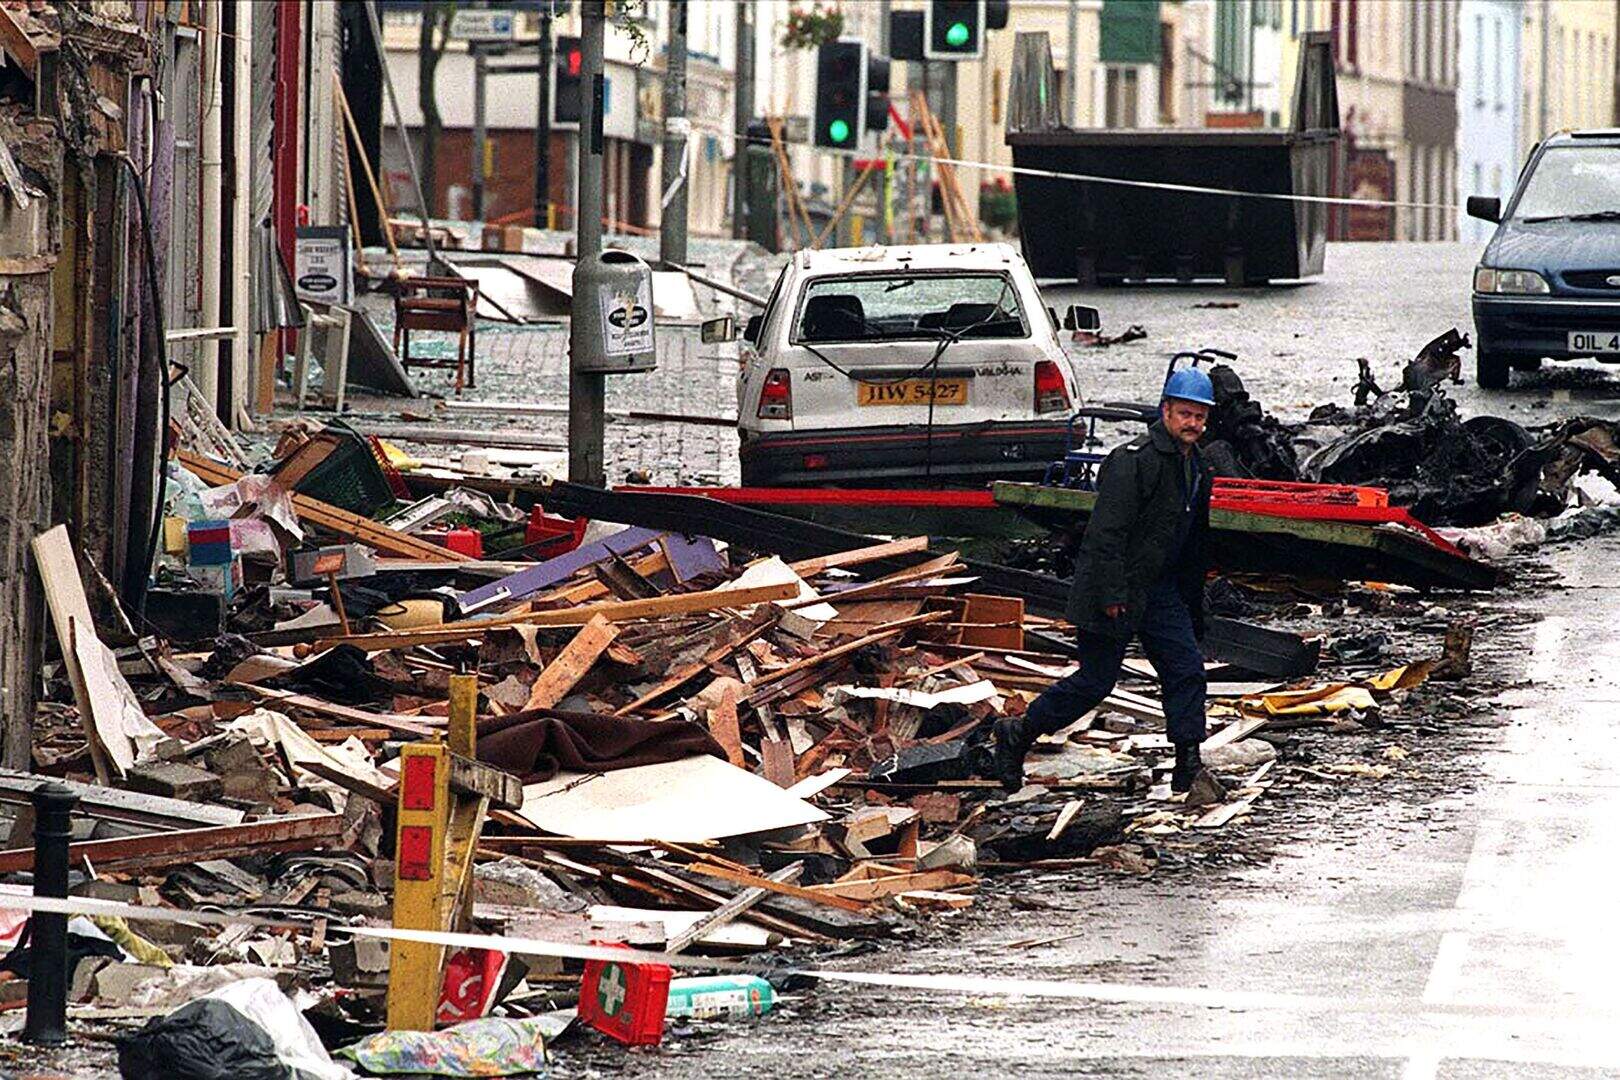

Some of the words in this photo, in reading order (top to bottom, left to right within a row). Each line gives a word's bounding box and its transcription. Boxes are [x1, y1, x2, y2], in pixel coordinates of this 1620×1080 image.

[1574, 334, 1603, 350] OIL
[1608, 334, 1619, 350] 4
[863, 384, 908, 404] JIW
[914, 383, 960, 399] 5427
